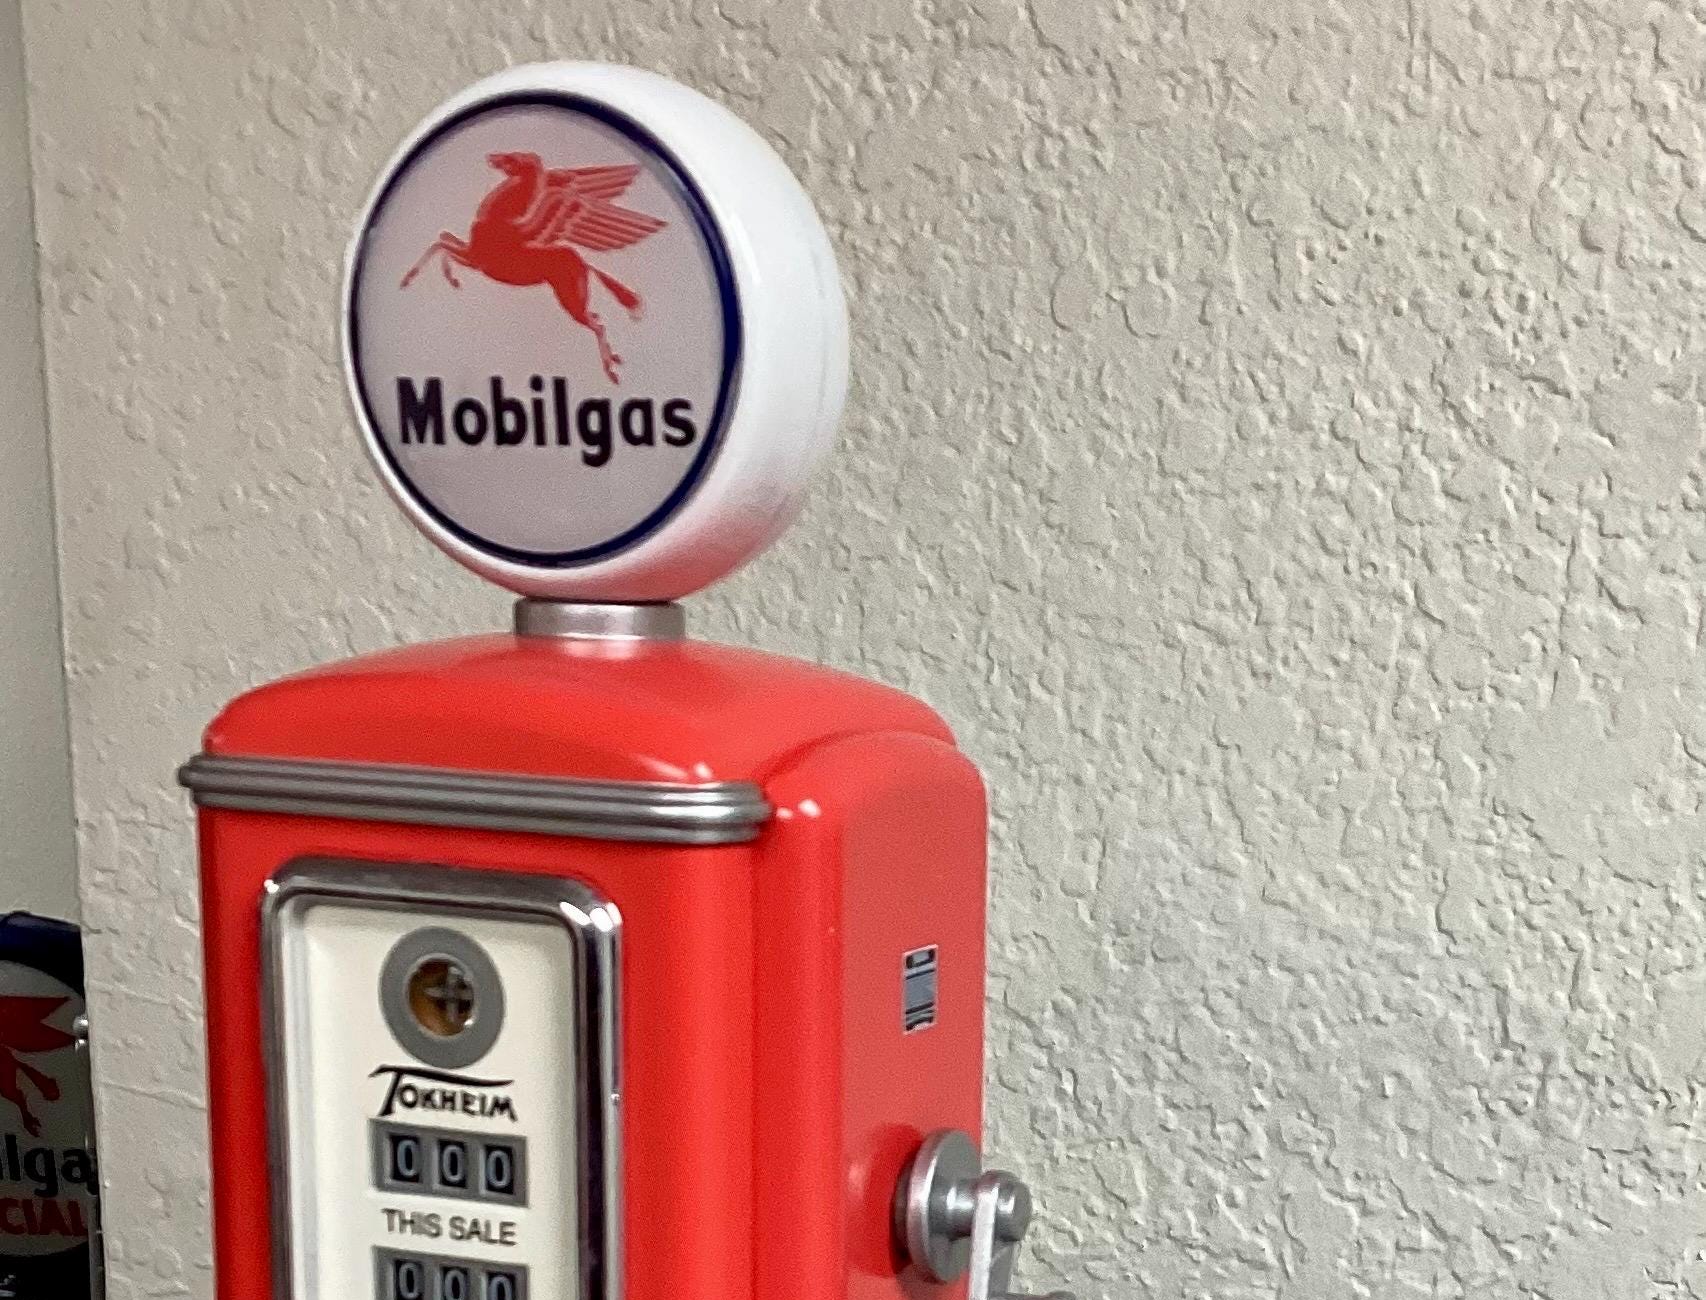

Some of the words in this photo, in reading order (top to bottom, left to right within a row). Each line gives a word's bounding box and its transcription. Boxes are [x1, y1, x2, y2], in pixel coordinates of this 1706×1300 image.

[395, 374, 696, 467] Mobilgas
[368, 1064, 518, 1122] TOKHEIM
[381, 1208, 442, 1238] THIS
[449, 1216, 518, 1246] SALE
